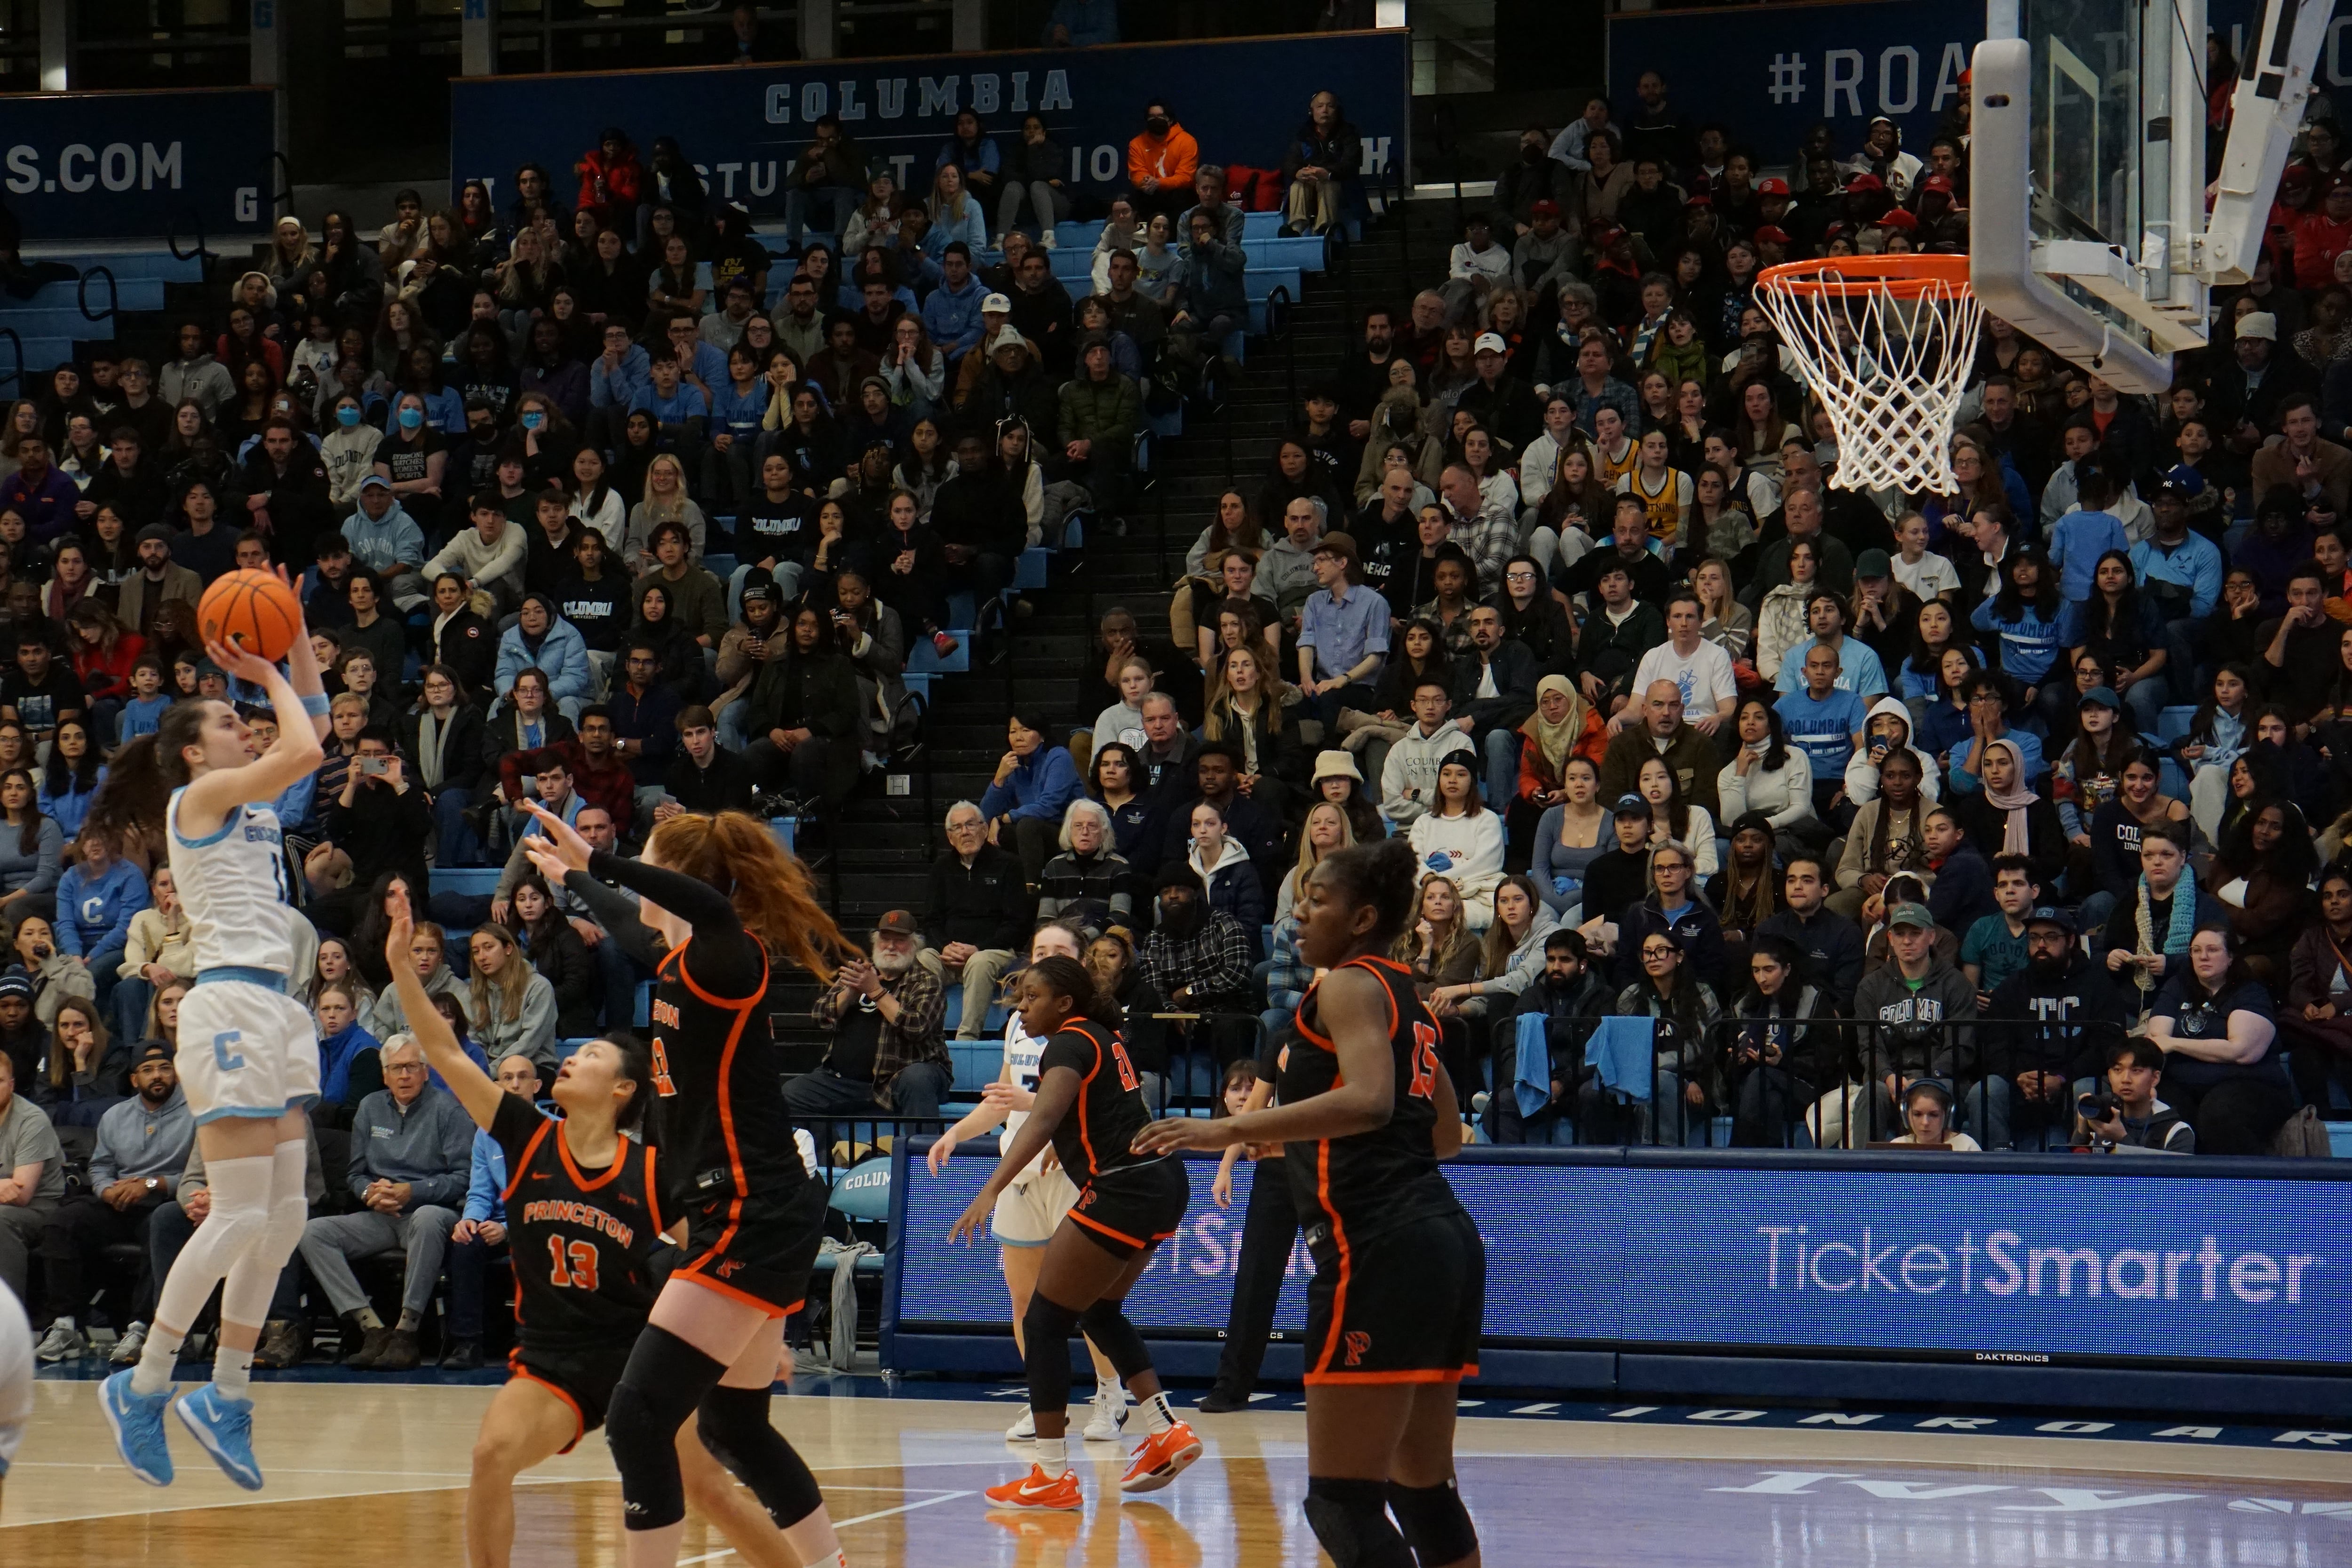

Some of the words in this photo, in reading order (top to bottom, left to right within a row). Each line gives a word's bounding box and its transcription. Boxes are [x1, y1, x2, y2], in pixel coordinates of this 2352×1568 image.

[764, 69, 1073, 124] COLUMBIA
[6, 140, 183, 195] S.COM
[1358, 137, 1392, 175] H
[235, 186, 258, 223] G
[892, 779, 904, 795] H
[83, 897, 103, 924] C
[214, 1032, 246, 1071] C
[1112, 1042, 1140, 1092] 21
[1408, 1021, 1440, 1102] 15
[524, 1200, 634, 1250] PRINCETON
[547, 1233, 600, 1292] 13
[1756, 1224, 2320, 1304] TicketSmarter
[1976, 1352, 2050, 1363] DAKTRONICS
